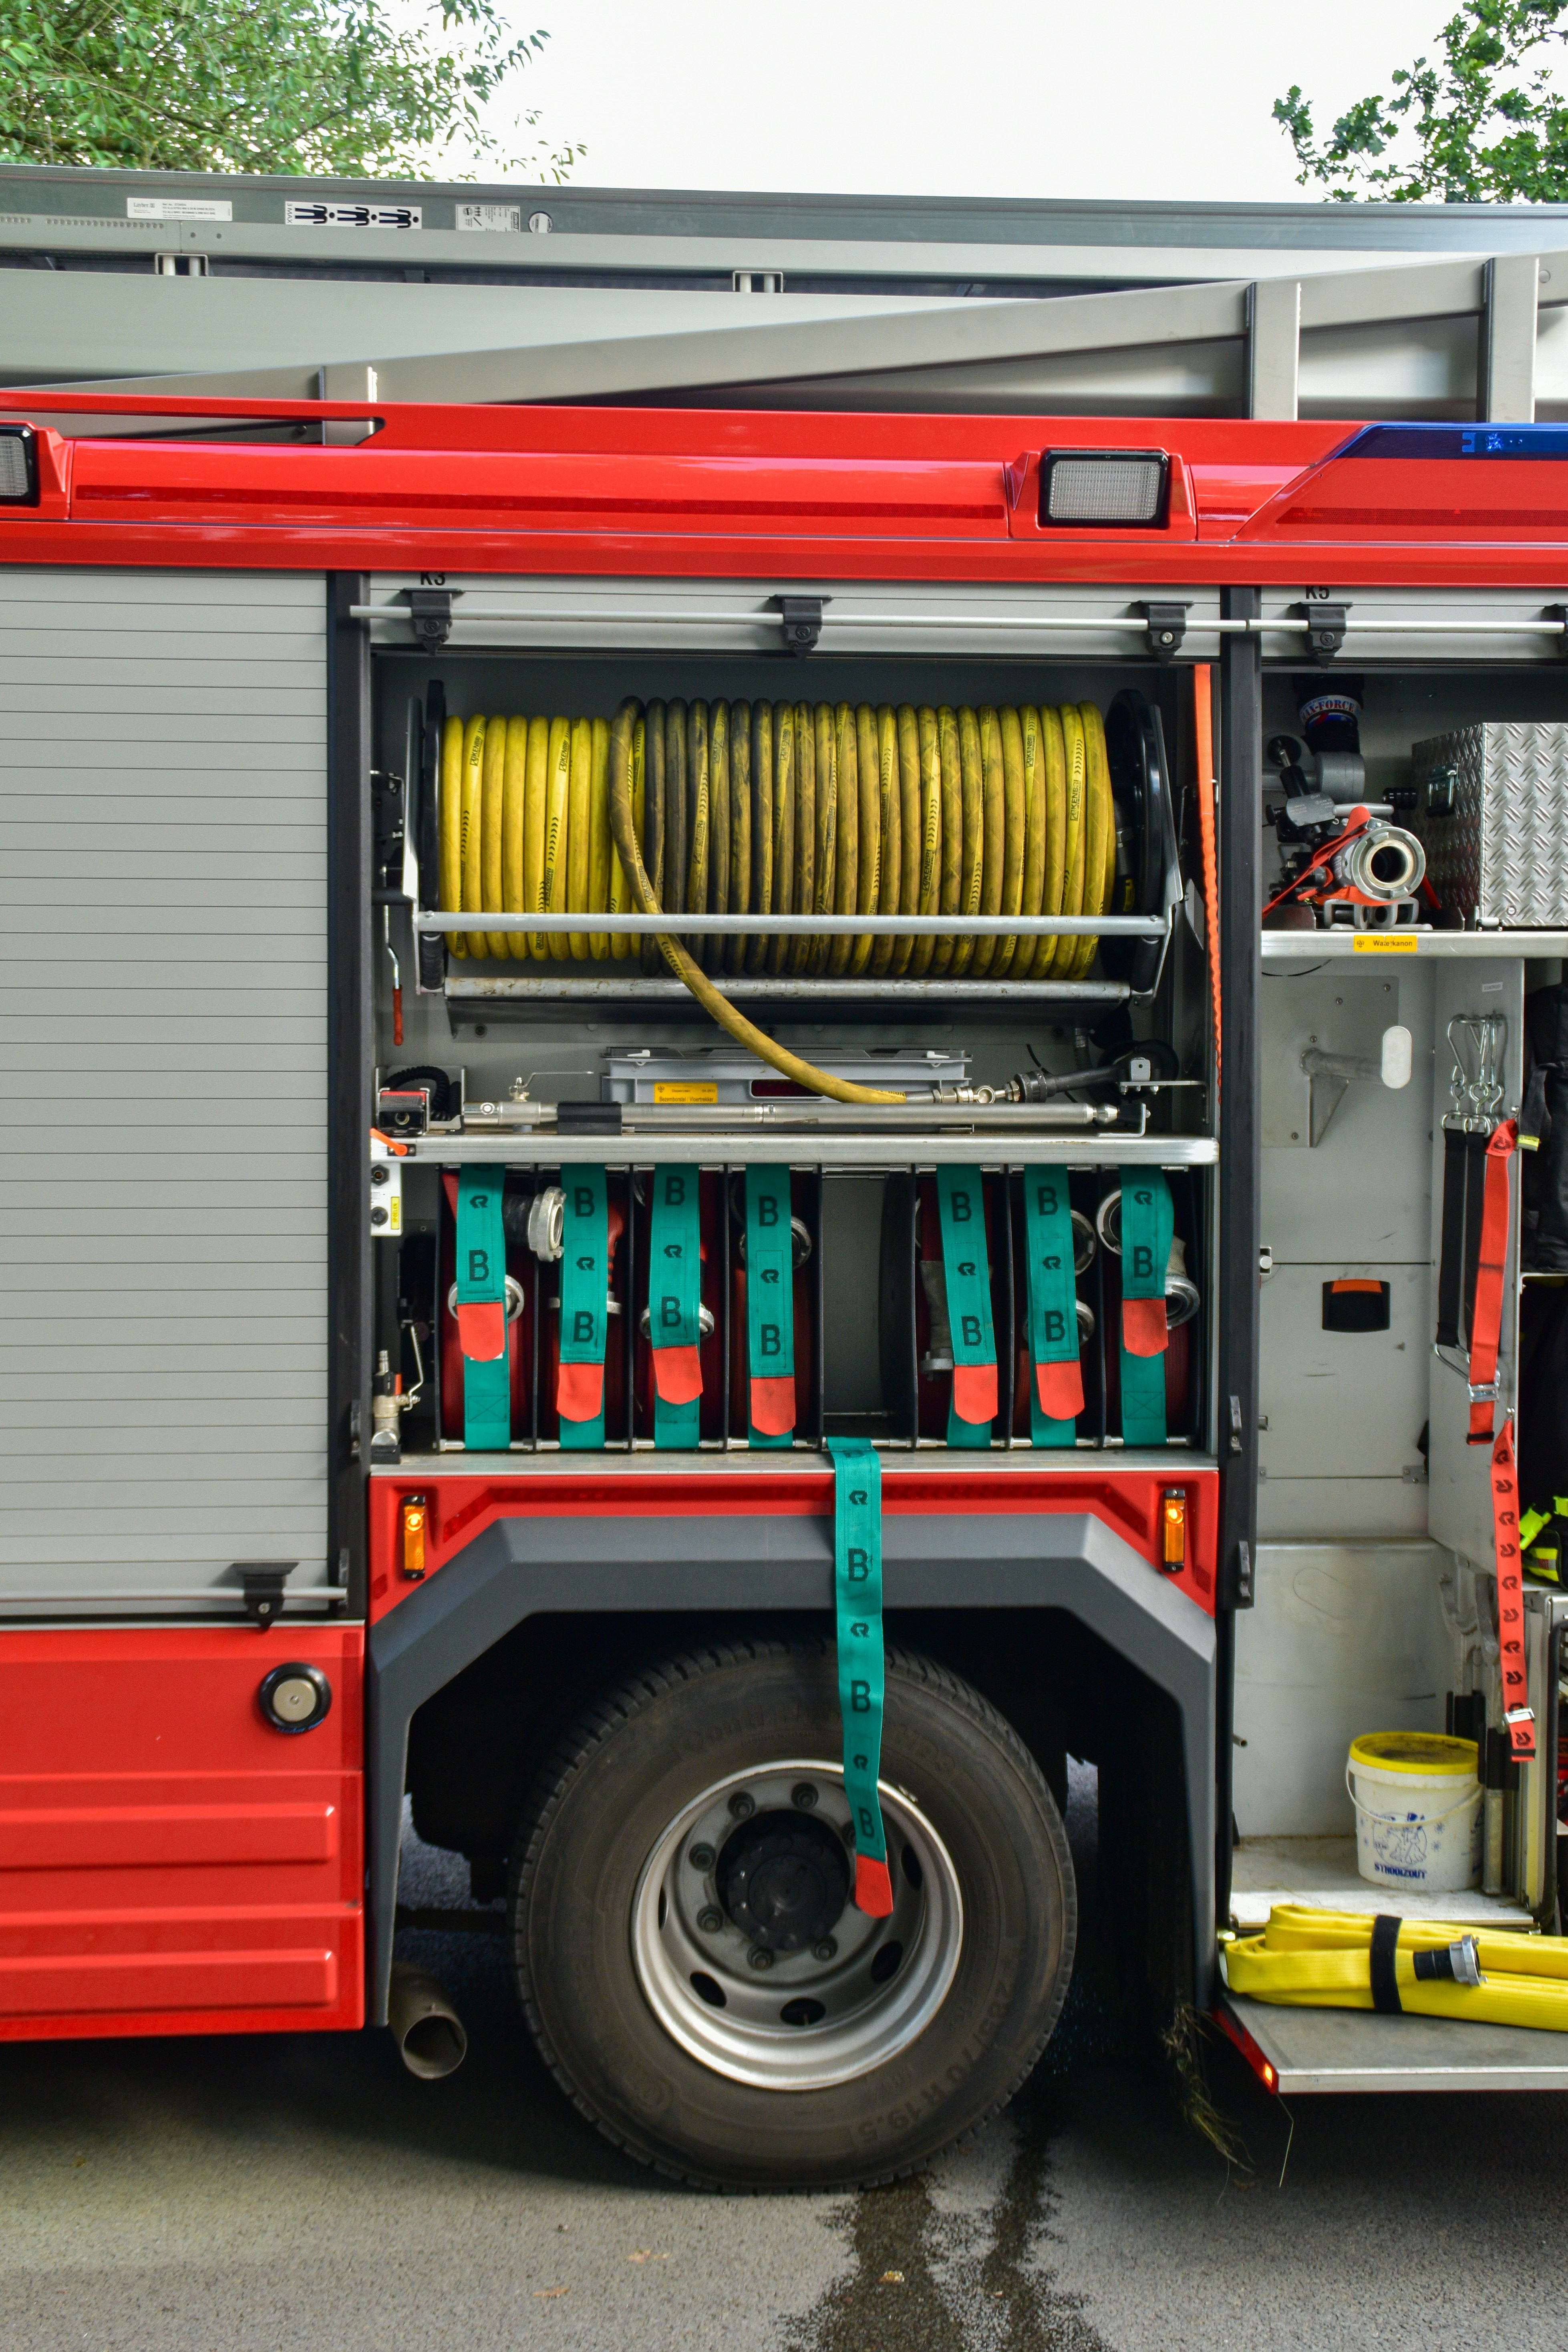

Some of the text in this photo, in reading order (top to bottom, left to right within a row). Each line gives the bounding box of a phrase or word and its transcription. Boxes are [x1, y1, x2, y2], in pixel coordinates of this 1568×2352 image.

[420, 572, 446, 586] K3
[1305, 586, 1330, 600] K5
[471, 735, 480, 756] KENBRI
[560, 740, 569, 761] KENBRI
[1071, 779, 1079, 810] KENBRI
[923, 850, 931, 880] KENBRI
[574, 1188, 595, 1218] B
[664, 1176, 685, 1206] B
[951, 1191, 972, 1222] B
[1038, 1186, 1059, 1216] B
[758, 1196, 779, 1227] B
[469, 1250, 490, 1281] B
[1133, 1246, 1153, 1278] B
[573, 1311, 594, 1343] B
[660, 1296, 681, 1327] B
[1044, 1310, 1066, 1342] B
[761, 1324, 781, 1356] B
[961, 1316, 982, 1347] B
[848, 1548, 869, 1582] B
[851, 1680, 871, 1713] B
[857, 1807, 875, 1838] B
